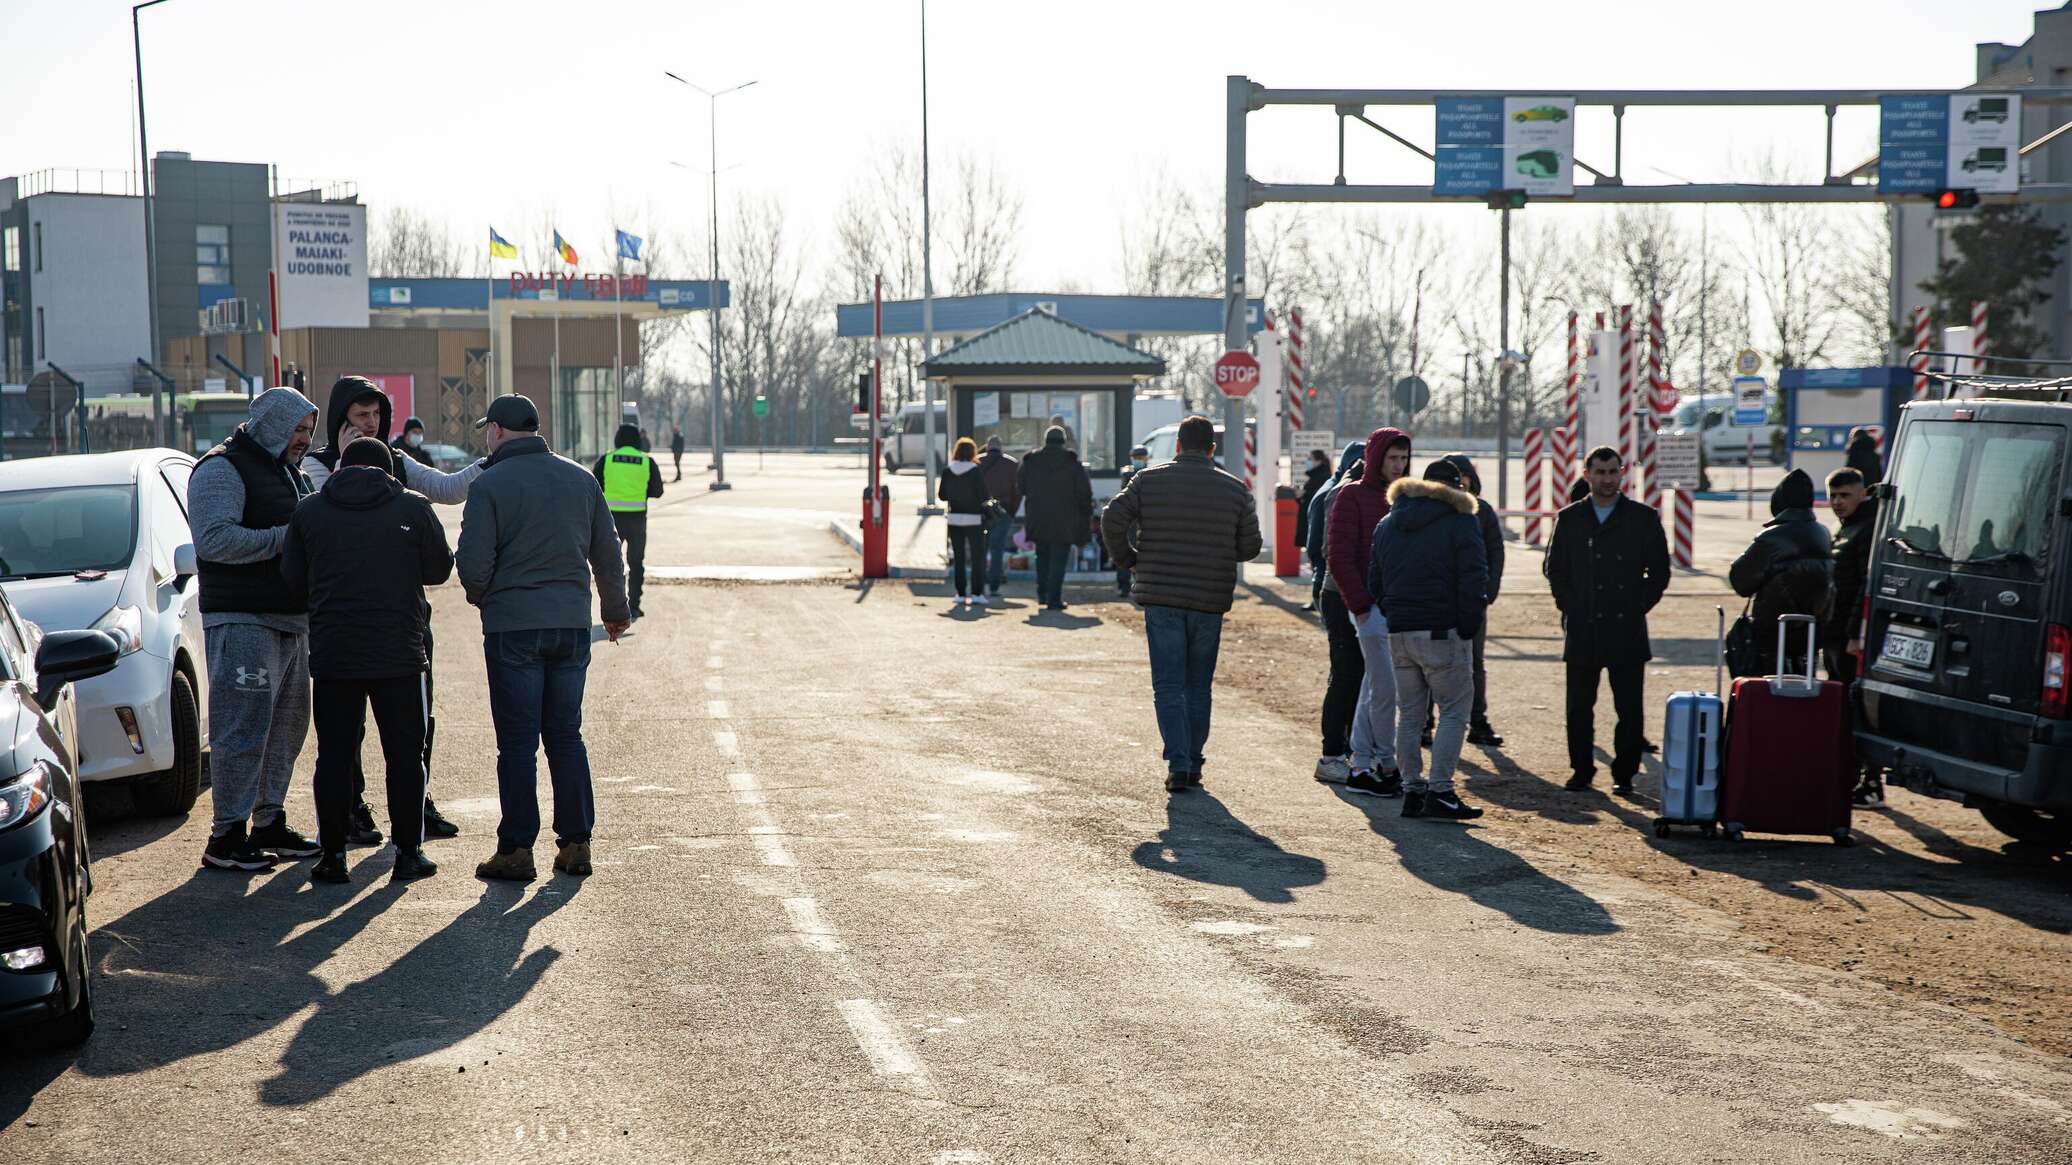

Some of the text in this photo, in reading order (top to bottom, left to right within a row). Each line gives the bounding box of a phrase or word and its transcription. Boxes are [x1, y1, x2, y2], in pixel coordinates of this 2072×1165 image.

[289, 230, 353, 245] PALANCA-
[295, 246, 347, 260] MAIAKI-
[287, 261, 352, 276] UDOBNOE
[510, 271, 576, 292] DUTY
[1218, 365, 1258, 382] STOP
